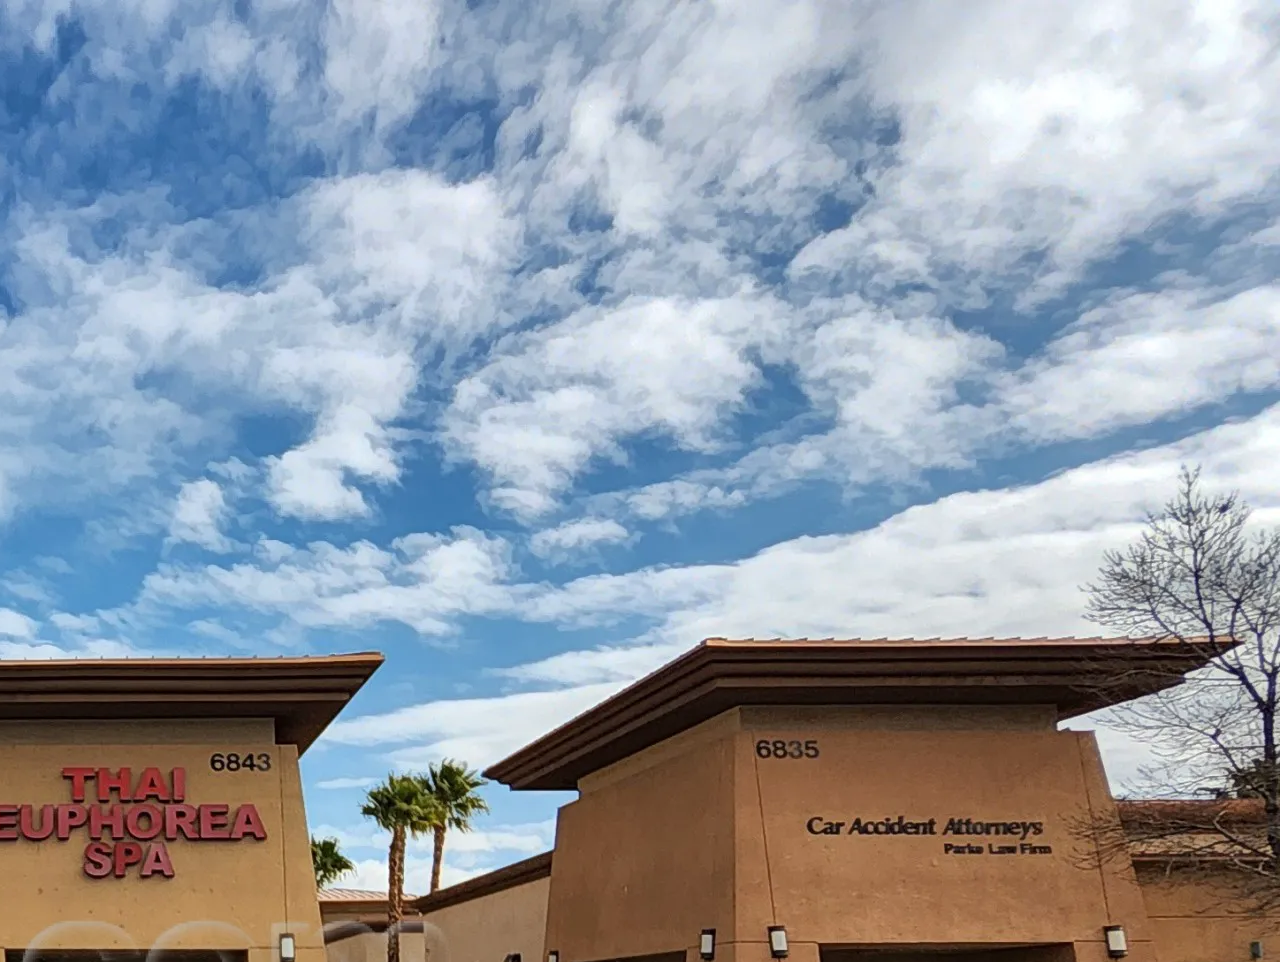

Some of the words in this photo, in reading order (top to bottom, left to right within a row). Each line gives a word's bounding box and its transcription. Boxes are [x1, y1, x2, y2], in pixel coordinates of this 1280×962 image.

[756, 740, 819, 759] 6835
[210, 753, 271, 772] 6843
[62, 767, 187, 802] THAI
[806, 816, 845, 835] Car
[848, 816, 937, 835] Accident
[942, 817, 1043, 840] Attorneys
[988, 843, 1017, 854] Law
[1020, 843, 1052, 854] Firm
[83, 842, 175, 879] SPA
